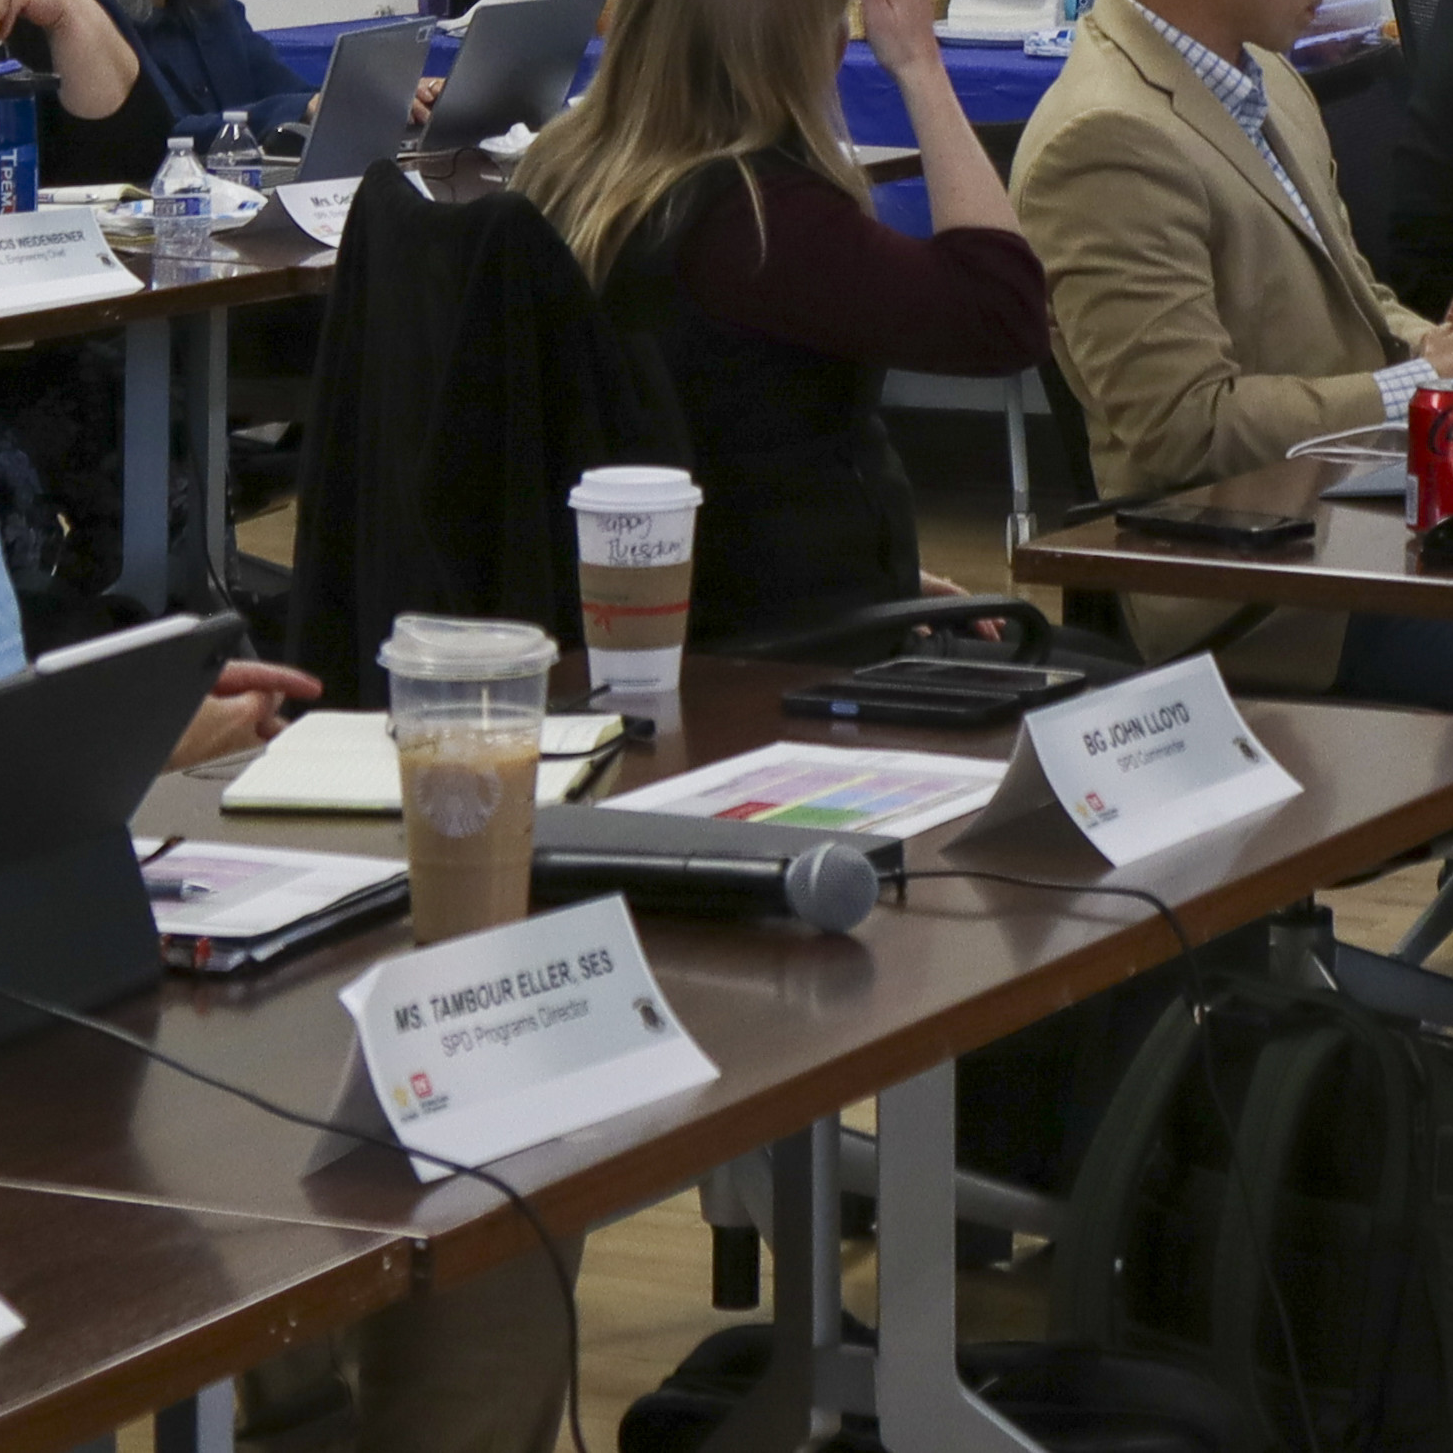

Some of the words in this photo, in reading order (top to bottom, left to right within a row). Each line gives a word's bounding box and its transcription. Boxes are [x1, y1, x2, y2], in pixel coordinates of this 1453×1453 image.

[18, 230, 86, 250] WEIDENBENER
[1083, 730, 1108, 757] BG
[1108, 716, 1146, 749] JOHN
[1143, 702, 1191, 735] LLOYD
[394, 1003, 427, 1034] MS.
[430, 976, 514, 1023] TAMBOUR
[516, 959, 578, 998] ELLER,
[577, 948, 615, 980] SES
[440, 1032, 474, 1058] SPD
[474, 1014, 539, 1047] Programs
[537, 997, 591, 1029] Director
